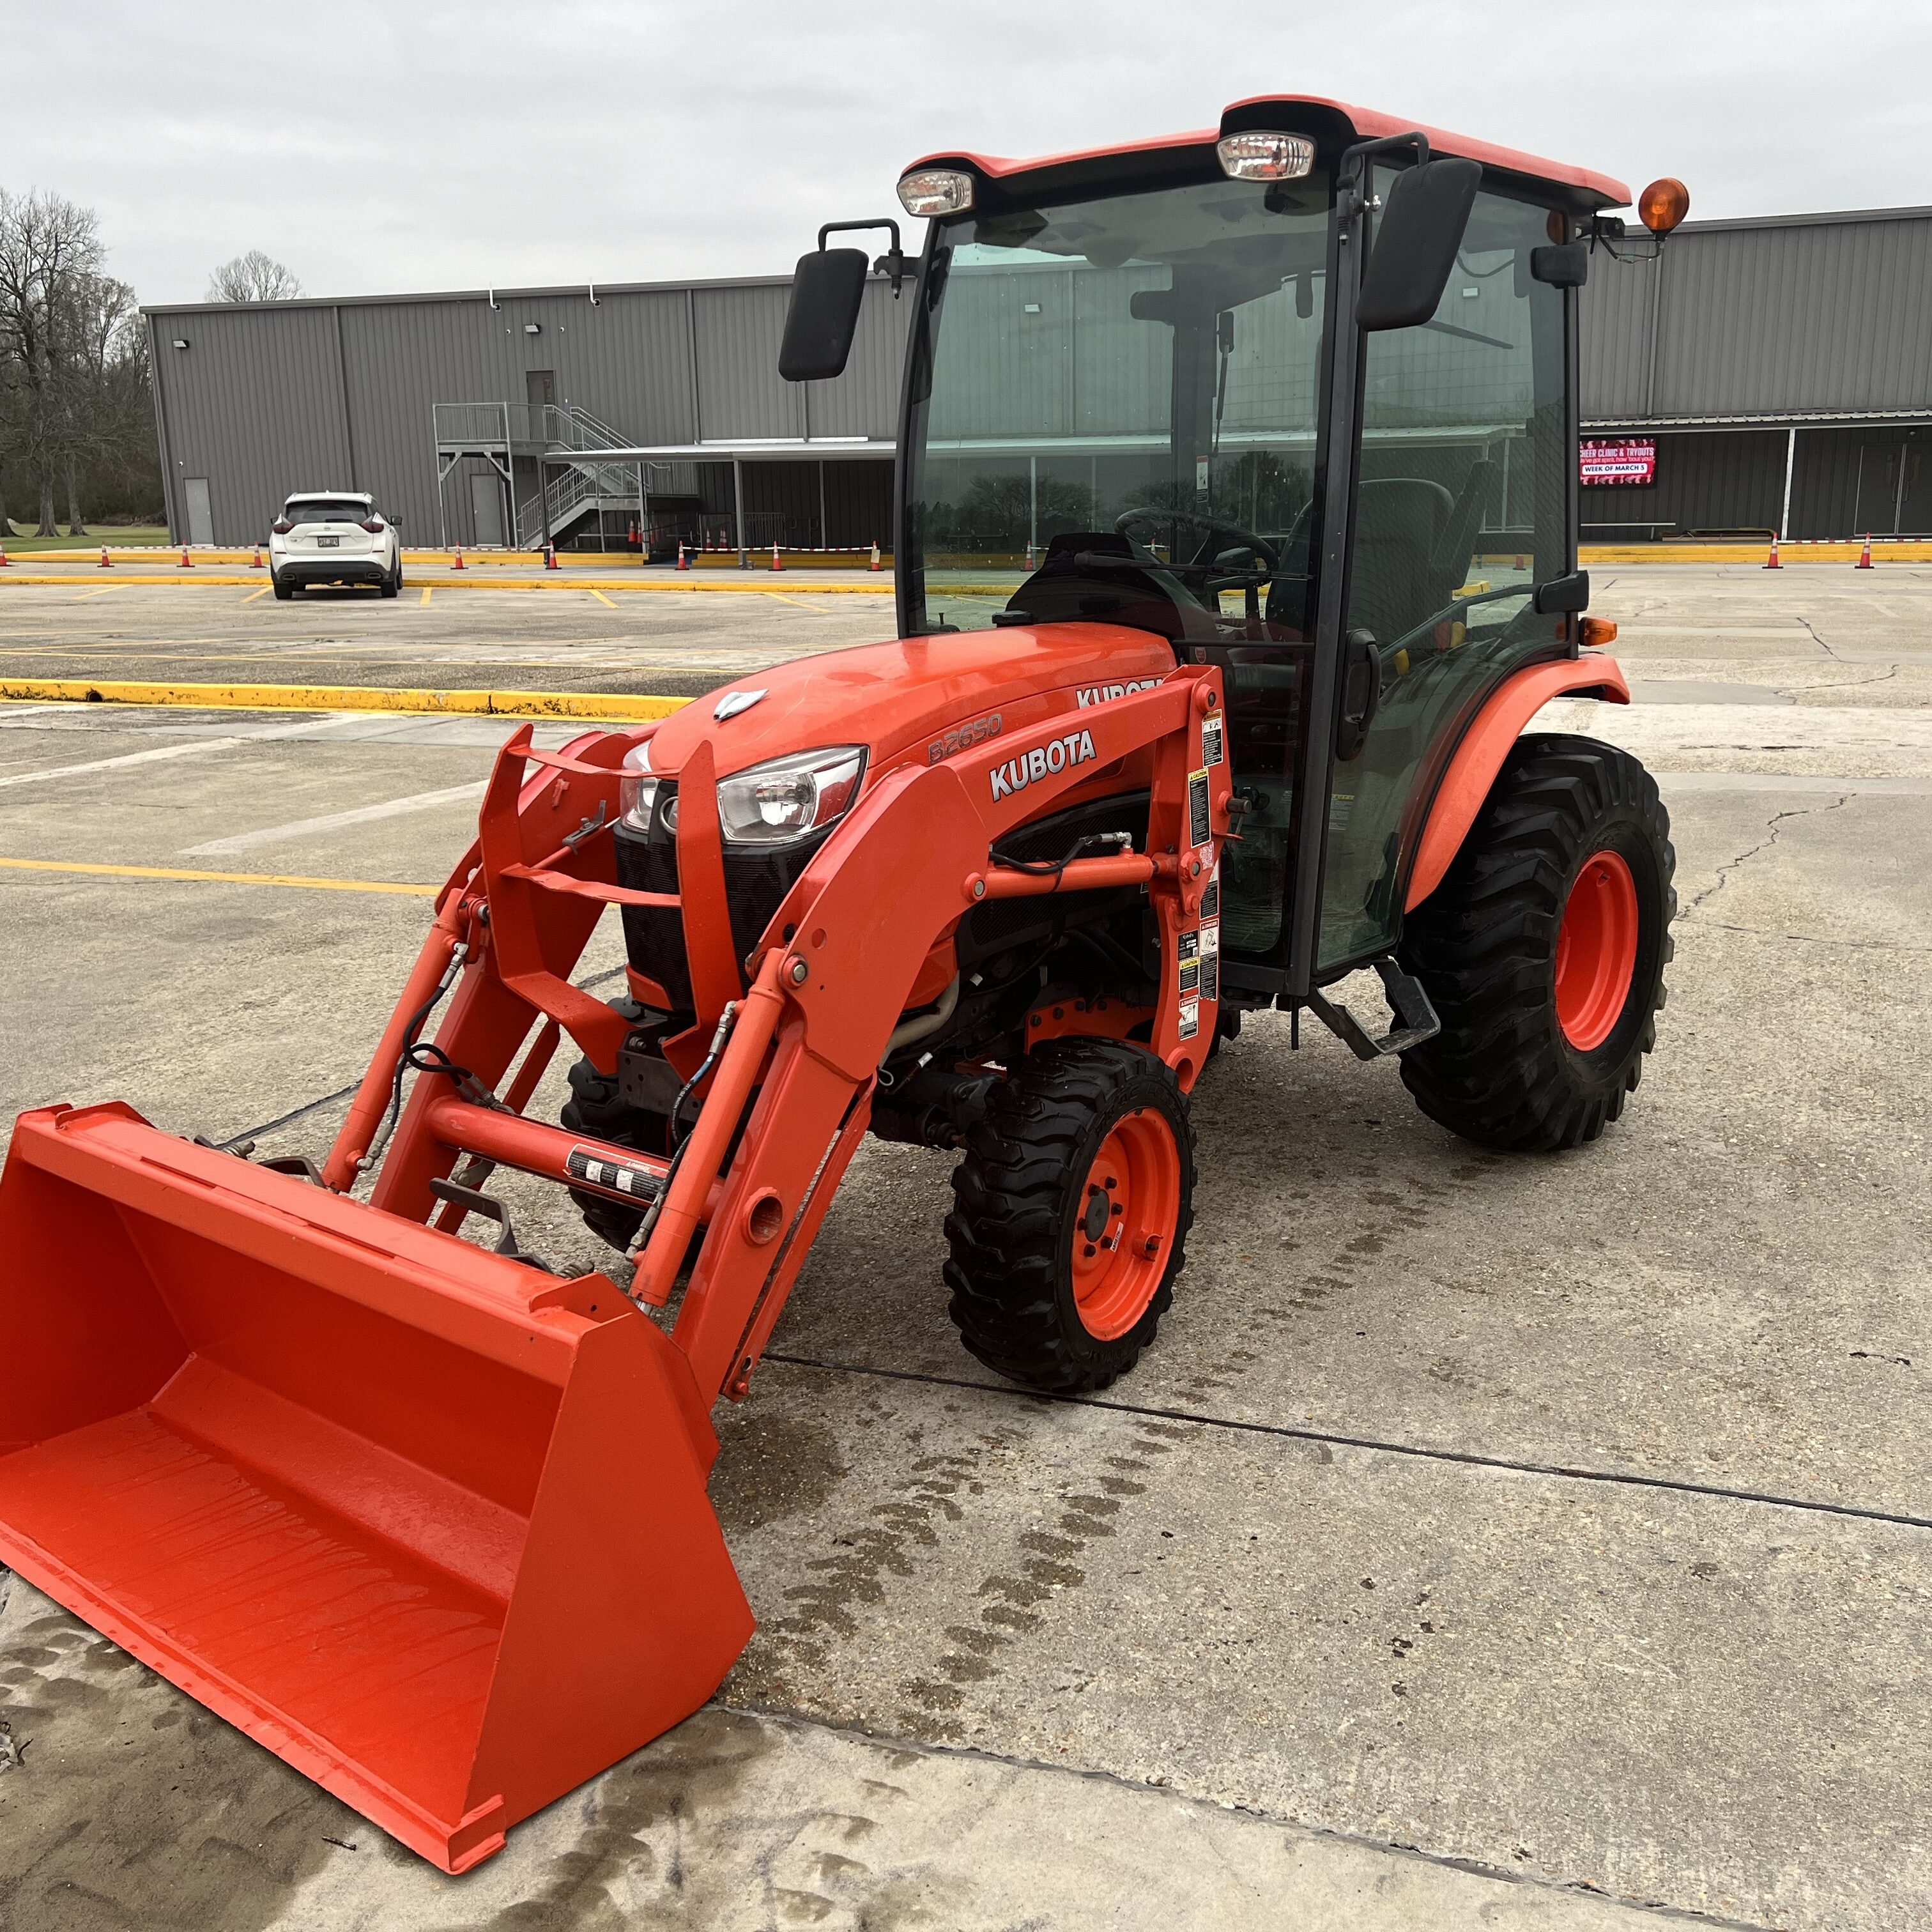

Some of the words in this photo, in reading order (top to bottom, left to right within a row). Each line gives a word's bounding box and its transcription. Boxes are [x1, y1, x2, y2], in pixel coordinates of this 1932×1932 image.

[1598, 448, 1618, 457] CLINIC
[1620, 448, 1624, 457] &
[1627, 447, 1654, 457] TRYOUTS
[1076, 678, 1163, 709] KUBO
[928, 713, 1002, 767] B2650
[990, 728, 1097, 803] KUBOTA
